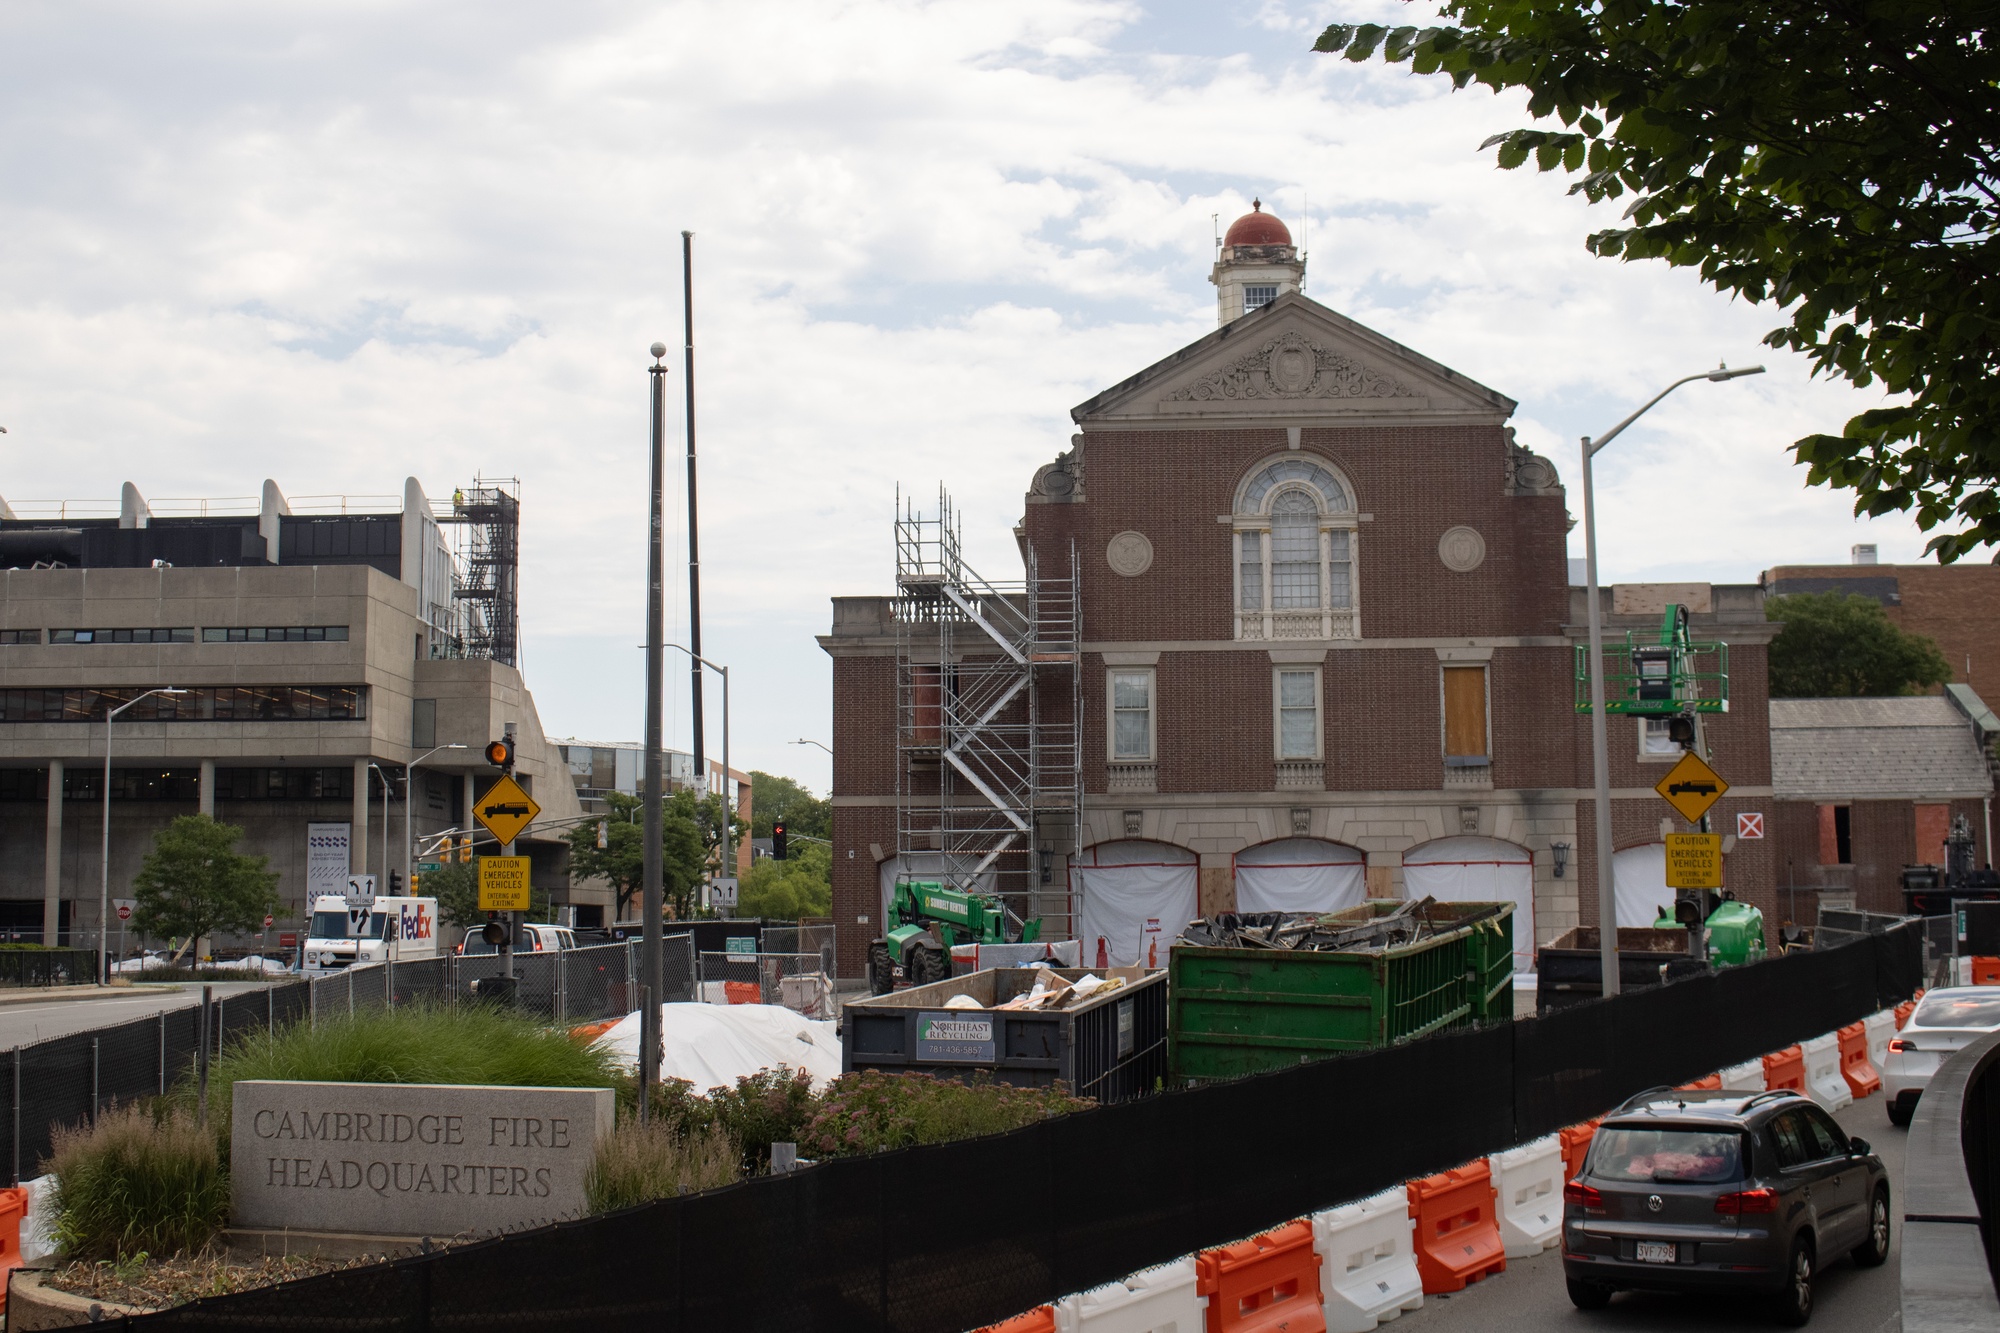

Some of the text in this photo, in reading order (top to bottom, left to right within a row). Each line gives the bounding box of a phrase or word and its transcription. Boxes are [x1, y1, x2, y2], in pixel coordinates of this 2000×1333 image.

[1675, 837, 1710, 845] CAUTION
[1671, 850, 1714, 858] EMERGENCY
[487, 860, 520, 868] CAUTION
[1673, 859, 1712, 868] VEHICLES
[484, 870, 524, 879] EMERGENCY
[486, 881, 522, 889] VEHICLES
[930, 897, 968, 916] SUNBELT RENTALS
[401, 904, 431, 940] FedEx
[892, 967, 904, 976] JCB
[930, 1021, 989, 1031] NORTHEAST
[930, 1031, 982, 1039] RECYCLING
[253, 1109, 571, 1148] CAMBRIDGE FIRE
[266, 1158, 551, 1198] HEADQUARTERS
[1638, 1245, 1674, 1258] 3VF 798
